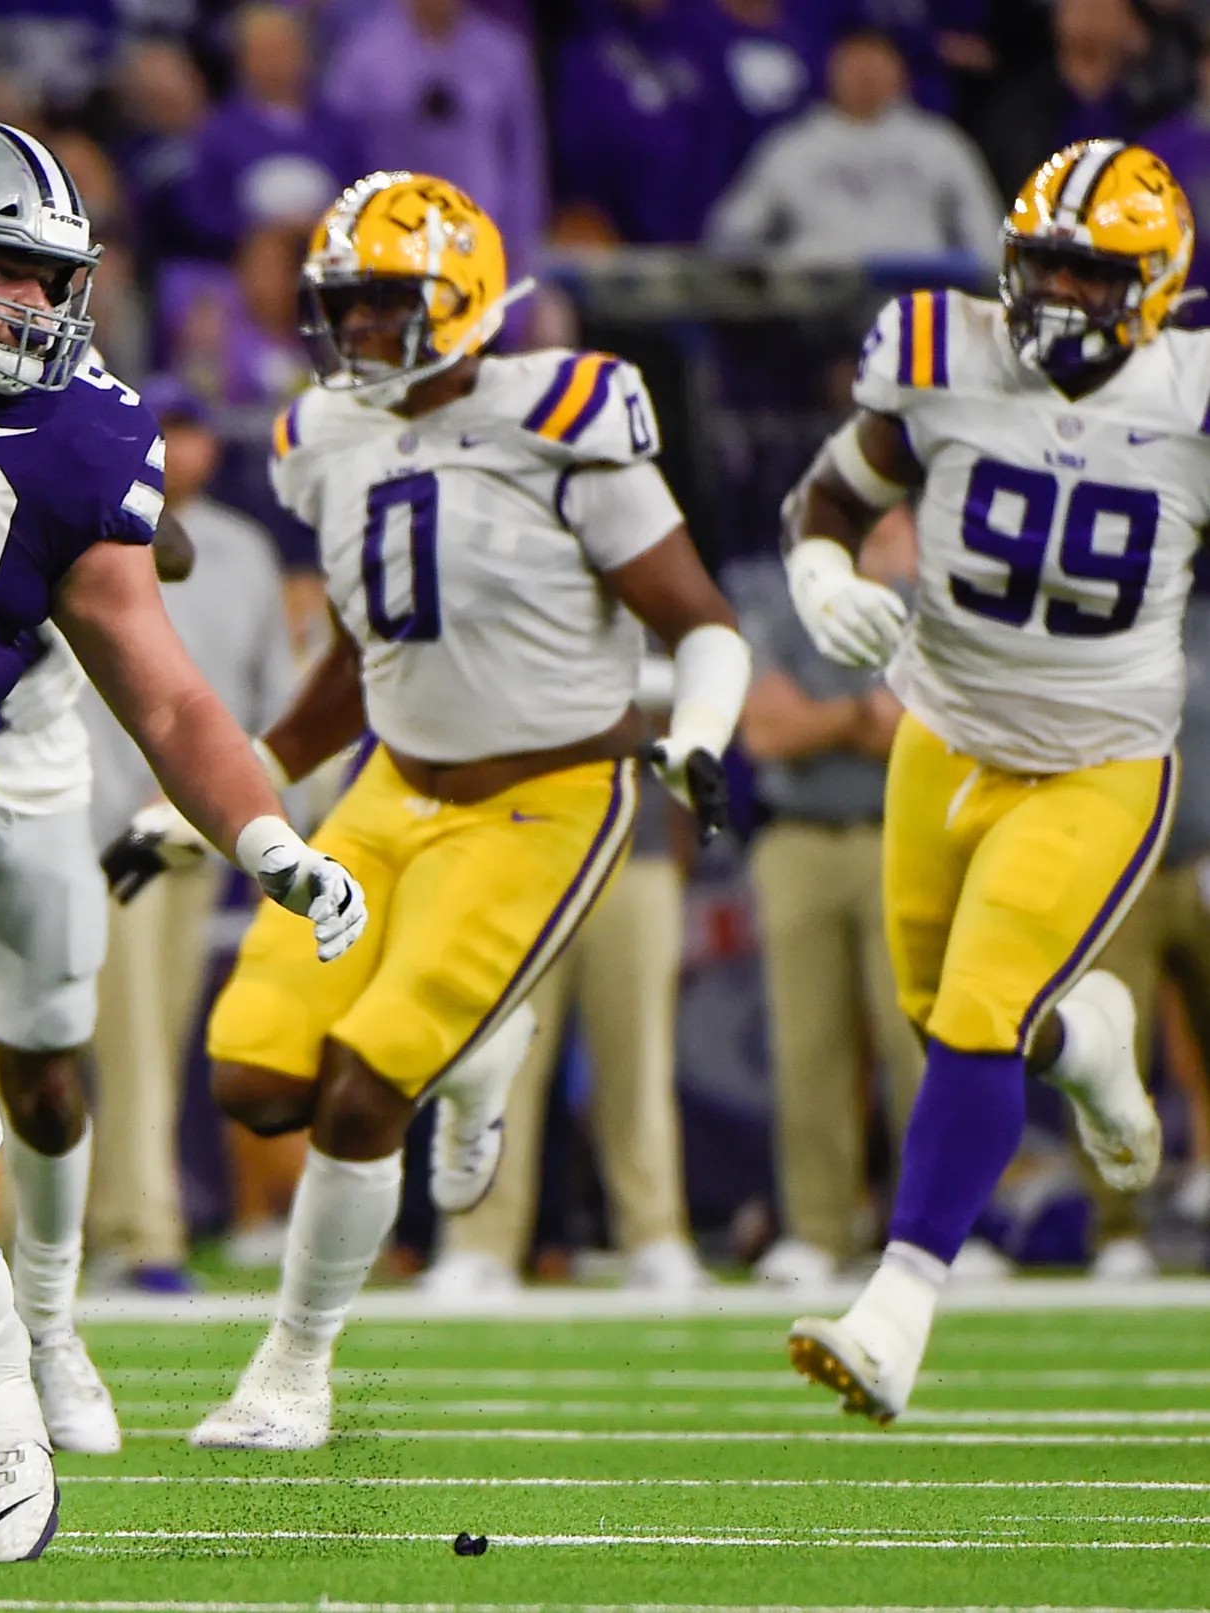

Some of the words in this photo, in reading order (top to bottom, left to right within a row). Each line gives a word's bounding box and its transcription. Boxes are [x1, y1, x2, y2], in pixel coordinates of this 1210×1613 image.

[625, 393, 651, 453] 0
[362, 471, 442, 643] 0
[948, 456, 1160, 638] 99
